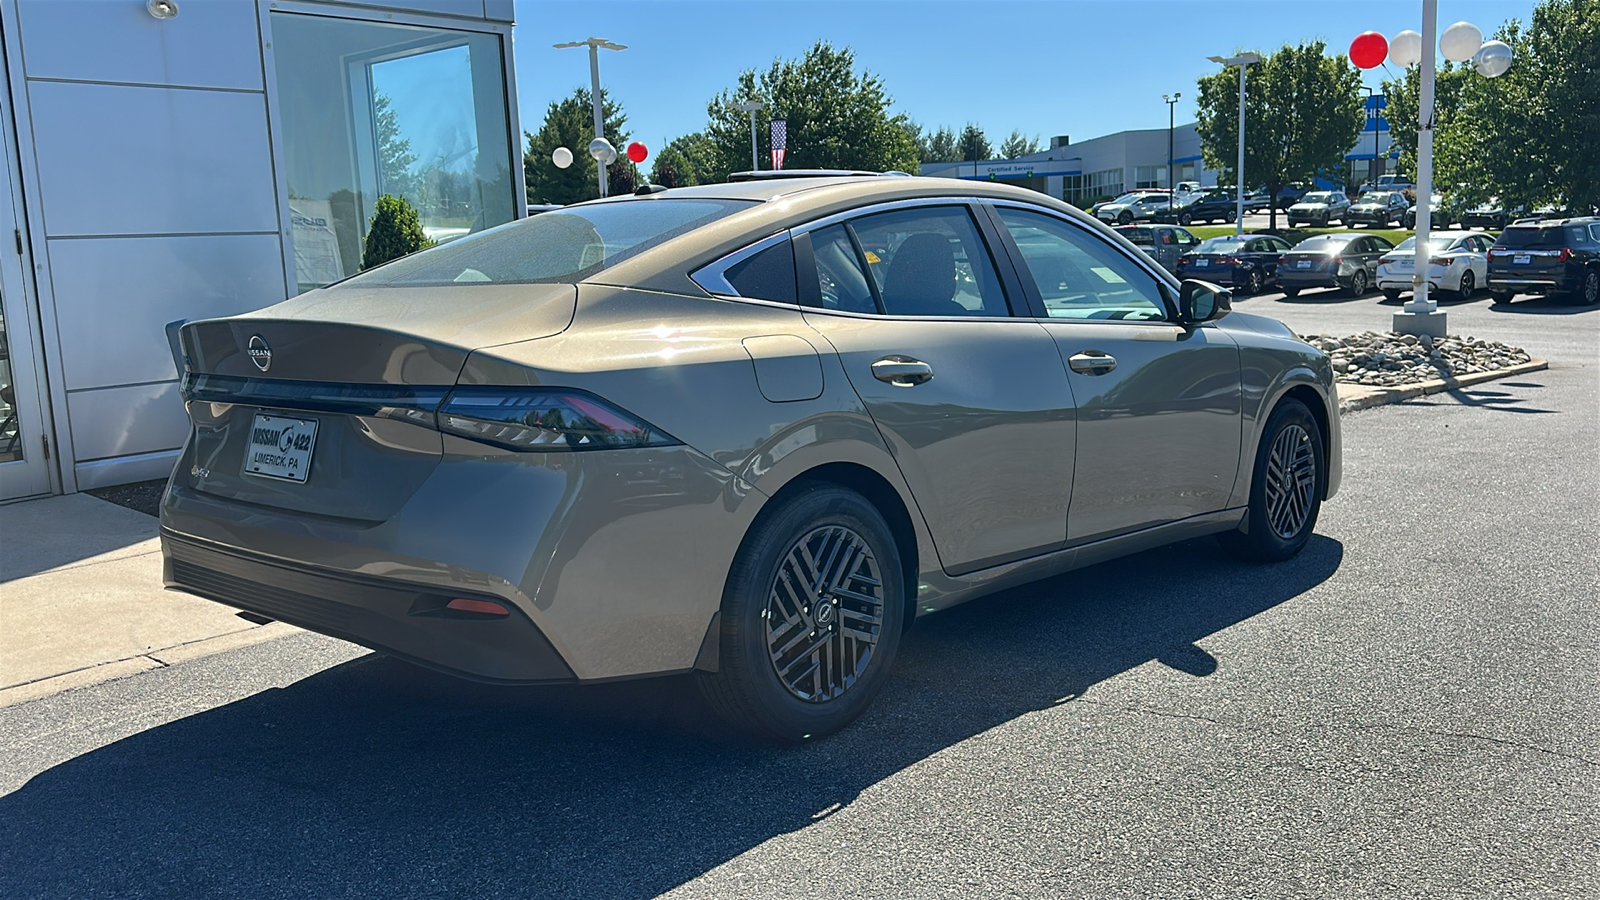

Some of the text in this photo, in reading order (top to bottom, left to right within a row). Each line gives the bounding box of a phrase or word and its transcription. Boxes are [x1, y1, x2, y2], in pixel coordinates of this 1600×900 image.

[987, 165, 1012, 173] Certified
[252, 427, 311, 452] NISSAN 422
[287, 457, 298, 469] PA
